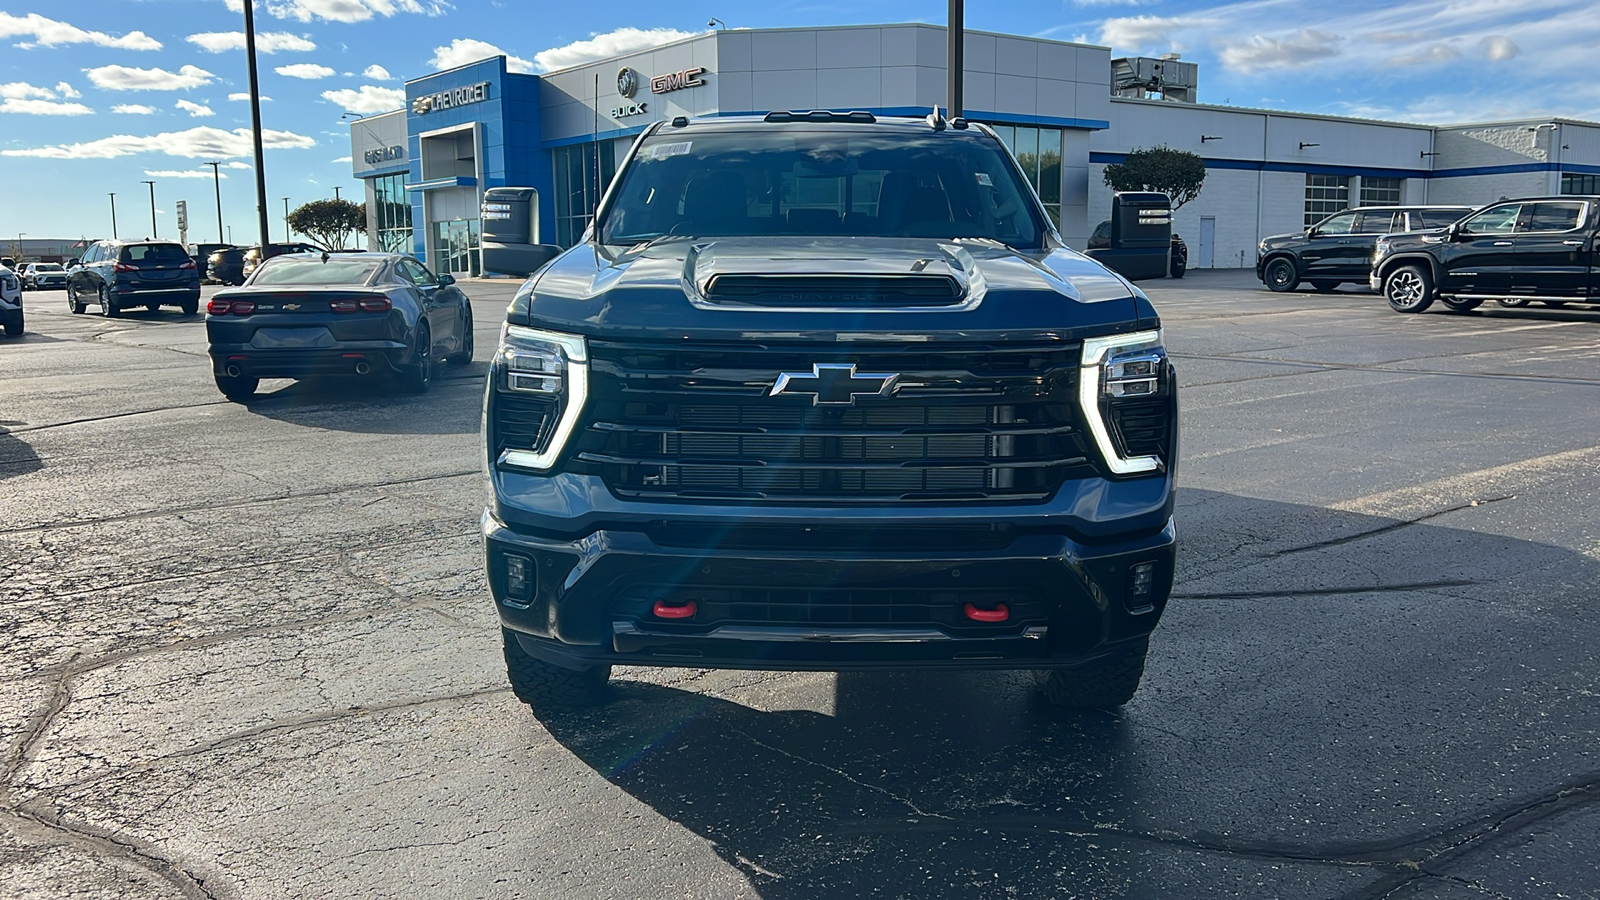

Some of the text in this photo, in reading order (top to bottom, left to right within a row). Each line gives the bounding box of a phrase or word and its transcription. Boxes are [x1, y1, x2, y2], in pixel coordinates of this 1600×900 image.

[650, 67, 703, 94] GMC
[430, 82, 490, 111] CHEVROLET
[611, 102, 645, 118] BUICK
